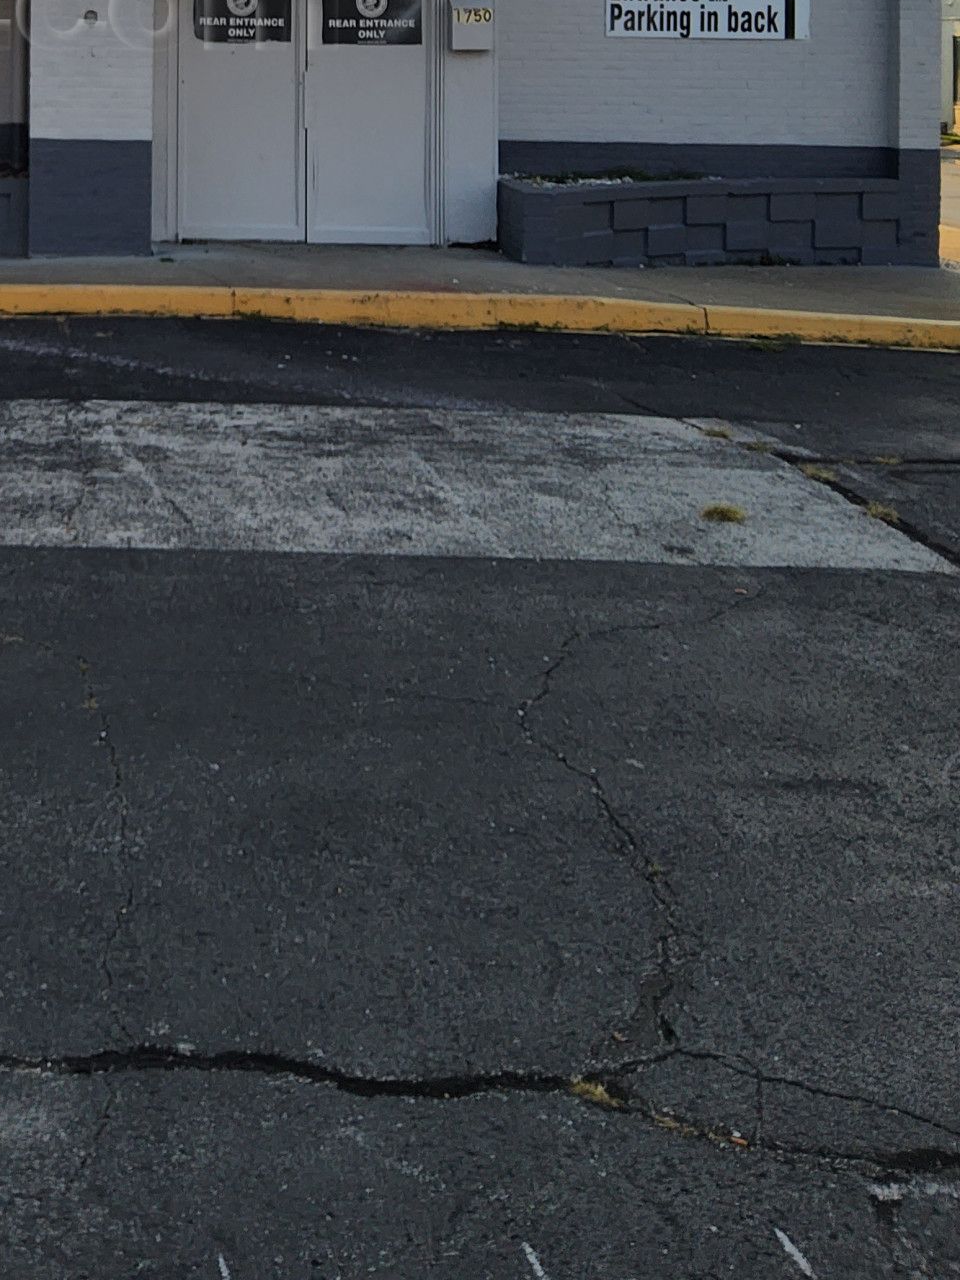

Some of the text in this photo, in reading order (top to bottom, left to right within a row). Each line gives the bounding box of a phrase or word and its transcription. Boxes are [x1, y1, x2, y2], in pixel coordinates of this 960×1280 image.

[453, 7, 492, 24] 1750
[199, 17, 285, 27] REAR ENTRANCE
[328, 19, 416, 28] REAR ENTRANCE
[609, 3, 779, 39] Parking in back
[227, 28, 256, 37] ONLY
[358, 29, 386, 39] ONLY
